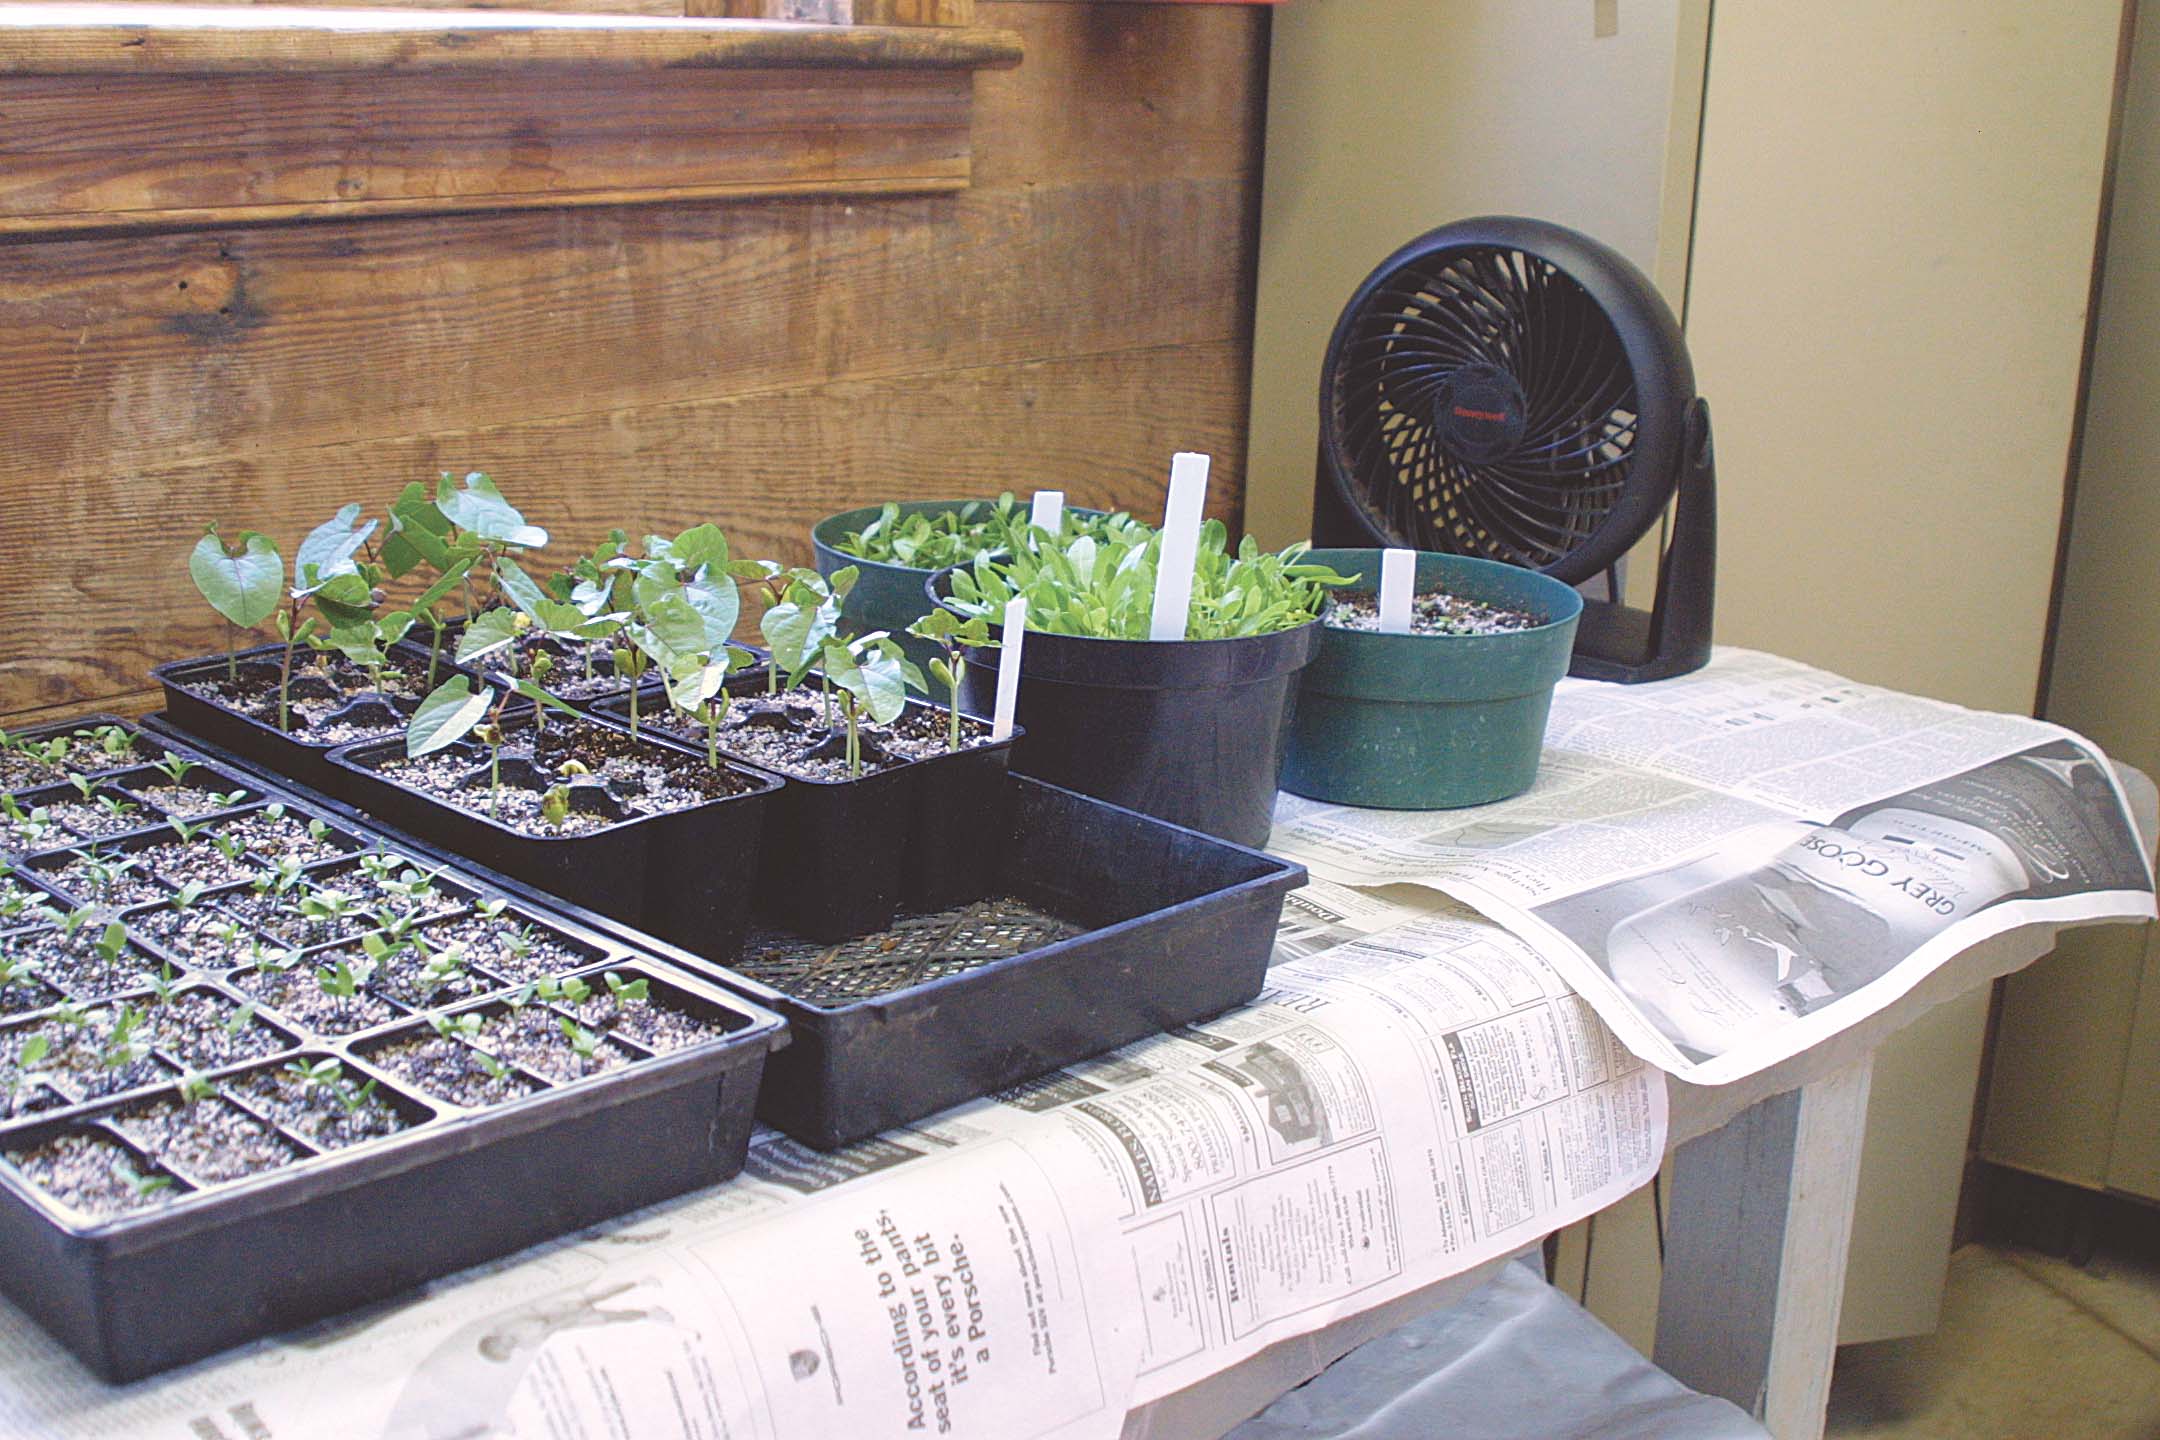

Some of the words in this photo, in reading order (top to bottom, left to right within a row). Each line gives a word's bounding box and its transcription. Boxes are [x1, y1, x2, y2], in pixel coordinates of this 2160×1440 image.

[1800, 835, 1889, 877] GOOSE
[1892, 876, 1956, 916] GREY
[1128, 1138, 1161, 1201] NAPLES
[854, 1228, 882, 1265] the
[876, 1208, 921, 1277] pants,
[913, 1231, 940, 1267] bit
[1005, 1228, 1018, 1245] the
[1012, 1248, 1027, 1278] about
[1222, 1227, 1239, 1302] Rentals
[878, 1271, 896, 1299] to
[950, 1233, 986, 1342] Porsche.
[910, 1287, 940, 1342] your
[934, 1274, 961, 1339] every
[889, 1302, 926, 1430] According
[920, 1349, 942, 1373] of
[949, 1346, 969, 1386] it's
[976, 1349, 990, 1363] a
[928, 1381, 951, 1434] seat
